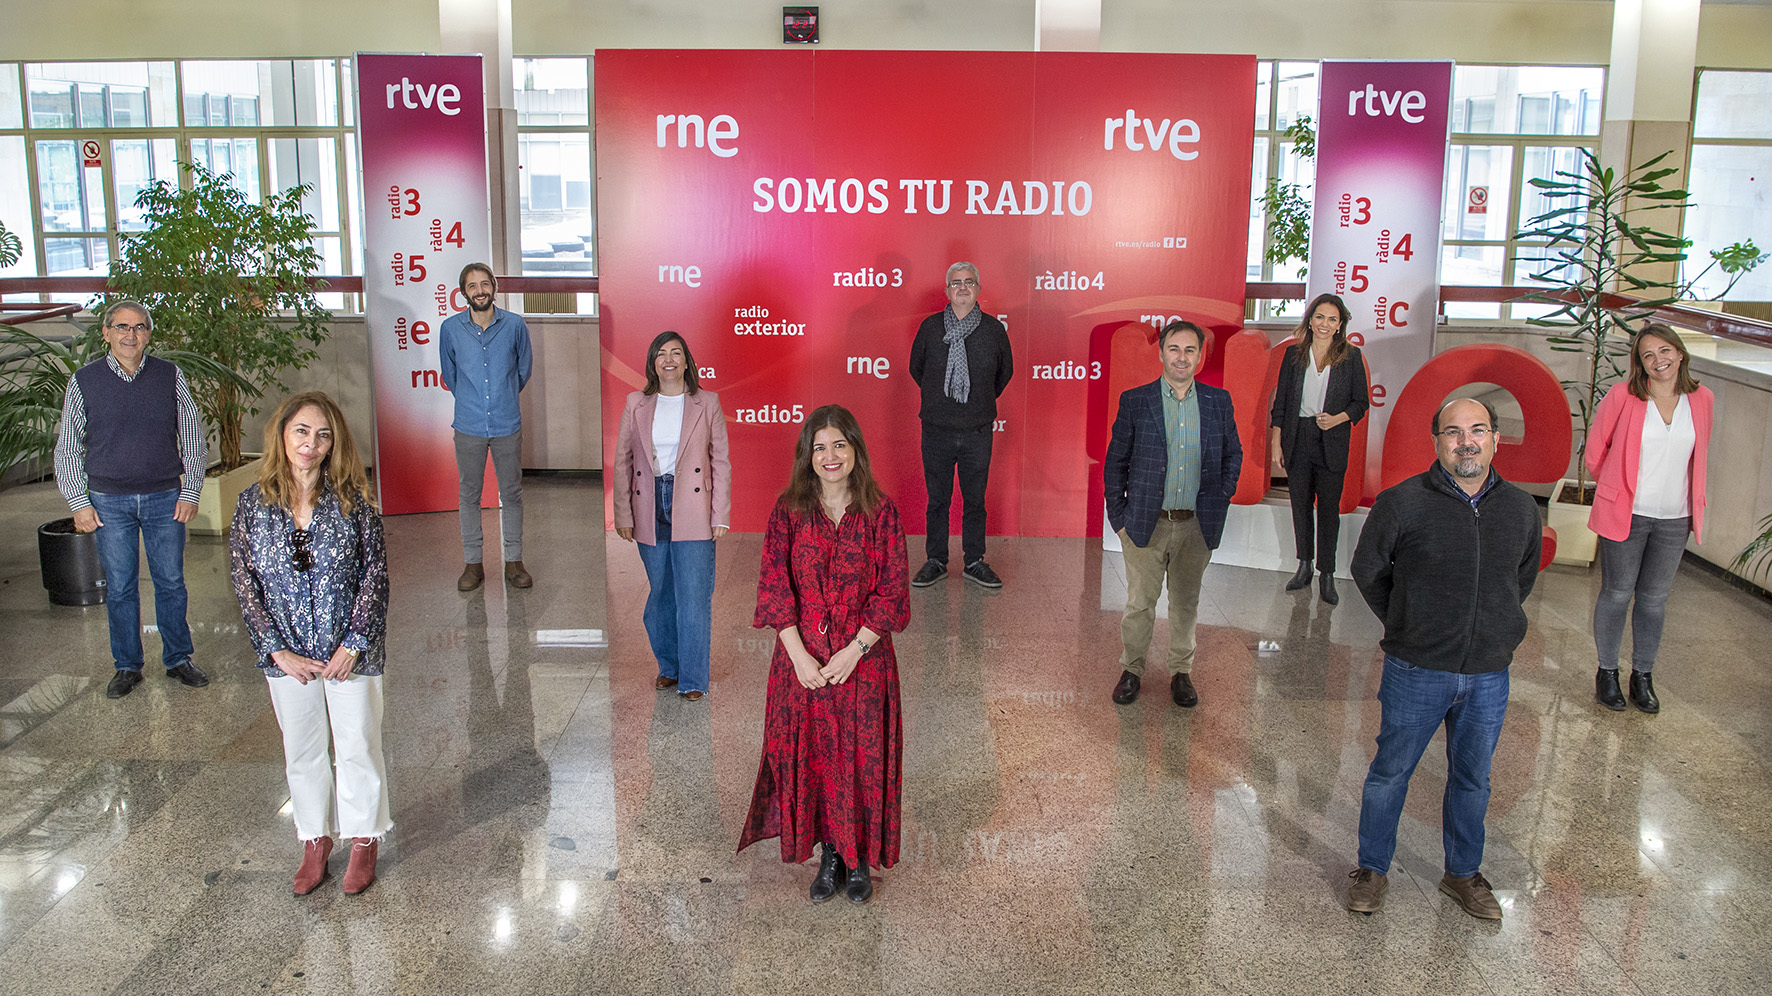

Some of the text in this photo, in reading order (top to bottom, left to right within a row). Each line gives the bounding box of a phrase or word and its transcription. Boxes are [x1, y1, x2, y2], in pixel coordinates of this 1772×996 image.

[386, 77, 461, 116] rtve
[1348, 83, 1426, 124] rtve
[656, 114, 739, 158] rne
[1104, 109, 1201, 161] rtve
[387, 185, 421, 220] radio 3
[753, 177, 1093, 217] SOMOS TU RADIO
[1338, 193, 1371, 228] radio 3
[445, 221, 466, 249] 4
[1115, 240, 1161, 249] rtve.es/radio
[1392, 233, 1414, 262] 4
[391, 252, 427, 286] radio 5
[658, 265, 702, 288] rne
[833, 267, 903, 287] radio 3
[1333, 261, 1369, 295] radio 5
[434, 283, 447, 317] radio
[734, 305, 769, 318] radio
[1374, 296, 1387, 330] radio
[395, 317, 430, 350] radio e
[734, 319, 806, 336] exterior
[411, 369, 450, 391] rn
[847, 356, 890, 379] rne
[1032, 360, 1101, 380] radio 3
